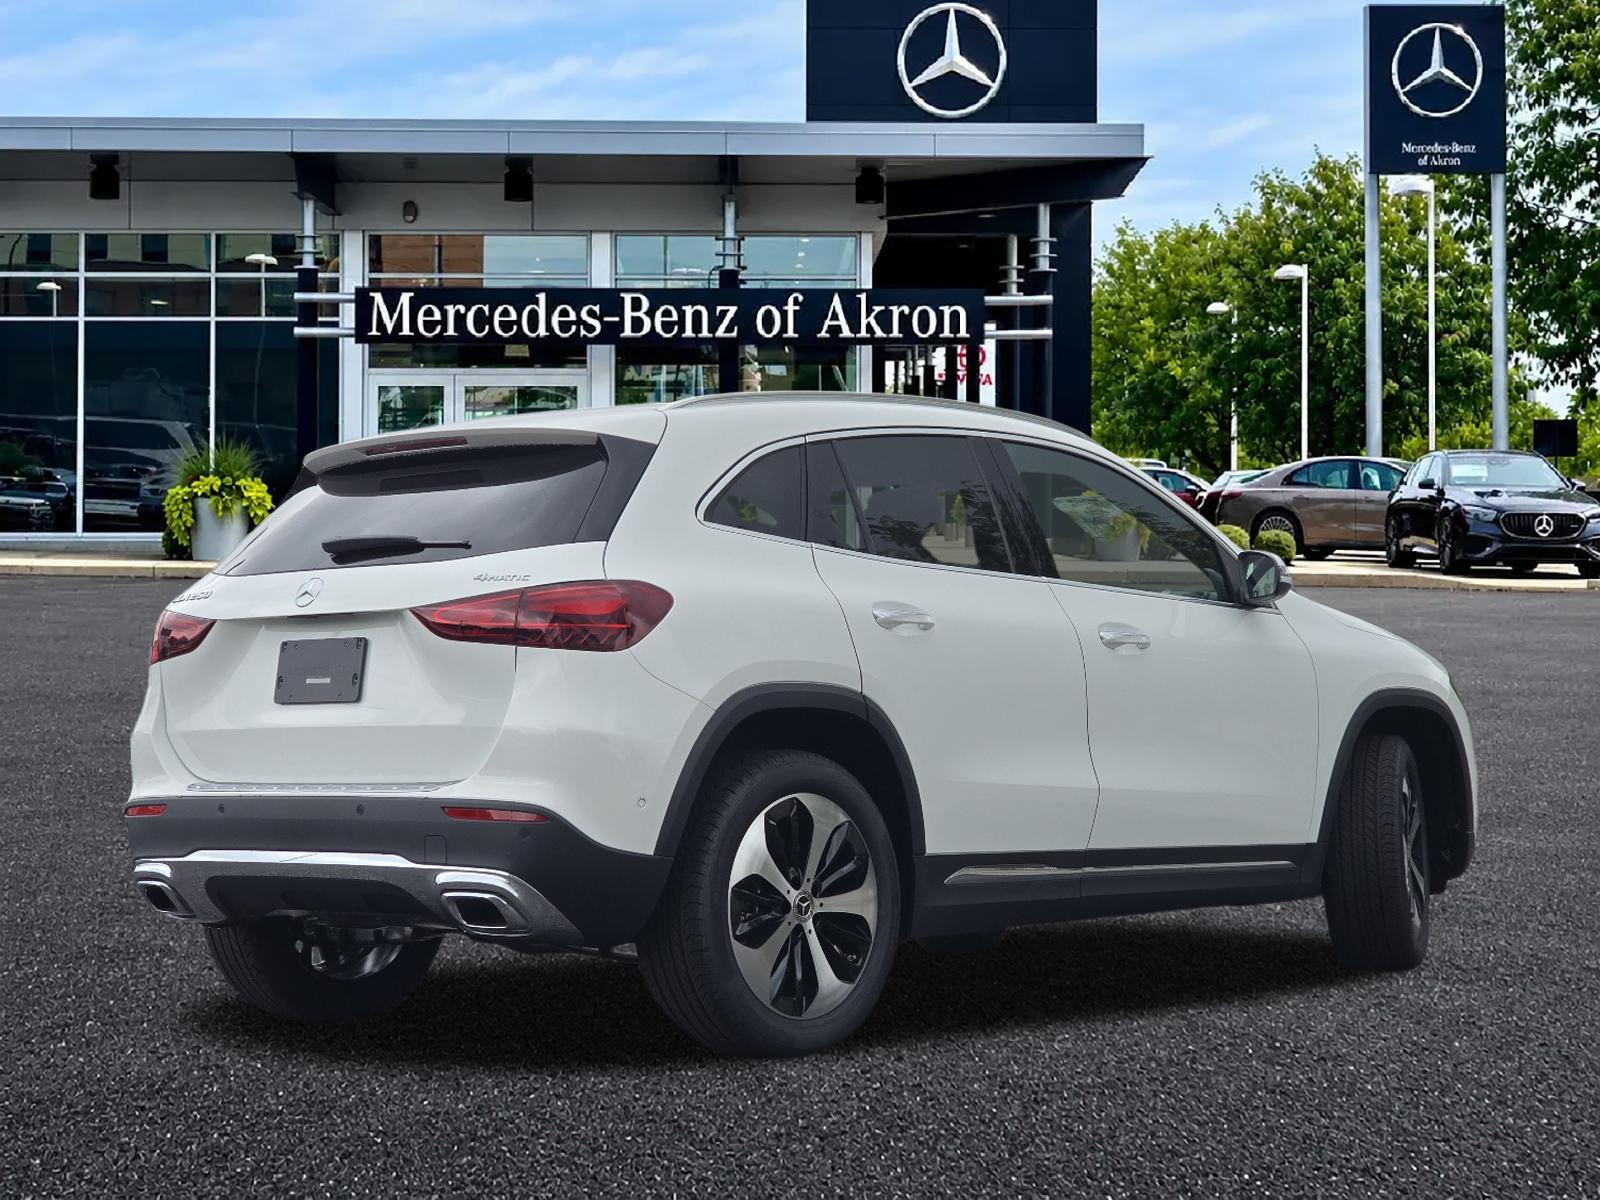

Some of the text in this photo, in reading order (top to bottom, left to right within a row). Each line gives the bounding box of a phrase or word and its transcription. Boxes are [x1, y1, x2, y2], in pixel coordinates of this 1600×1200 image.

[1401, 142, 1476, 153] Mercedes-Benz
[1418, 154, 1461, 166] of Akron
[367, 291, 970, 338] Mercedes-Benz of Akron
[473, 572, 531, 582] 4MATIC
